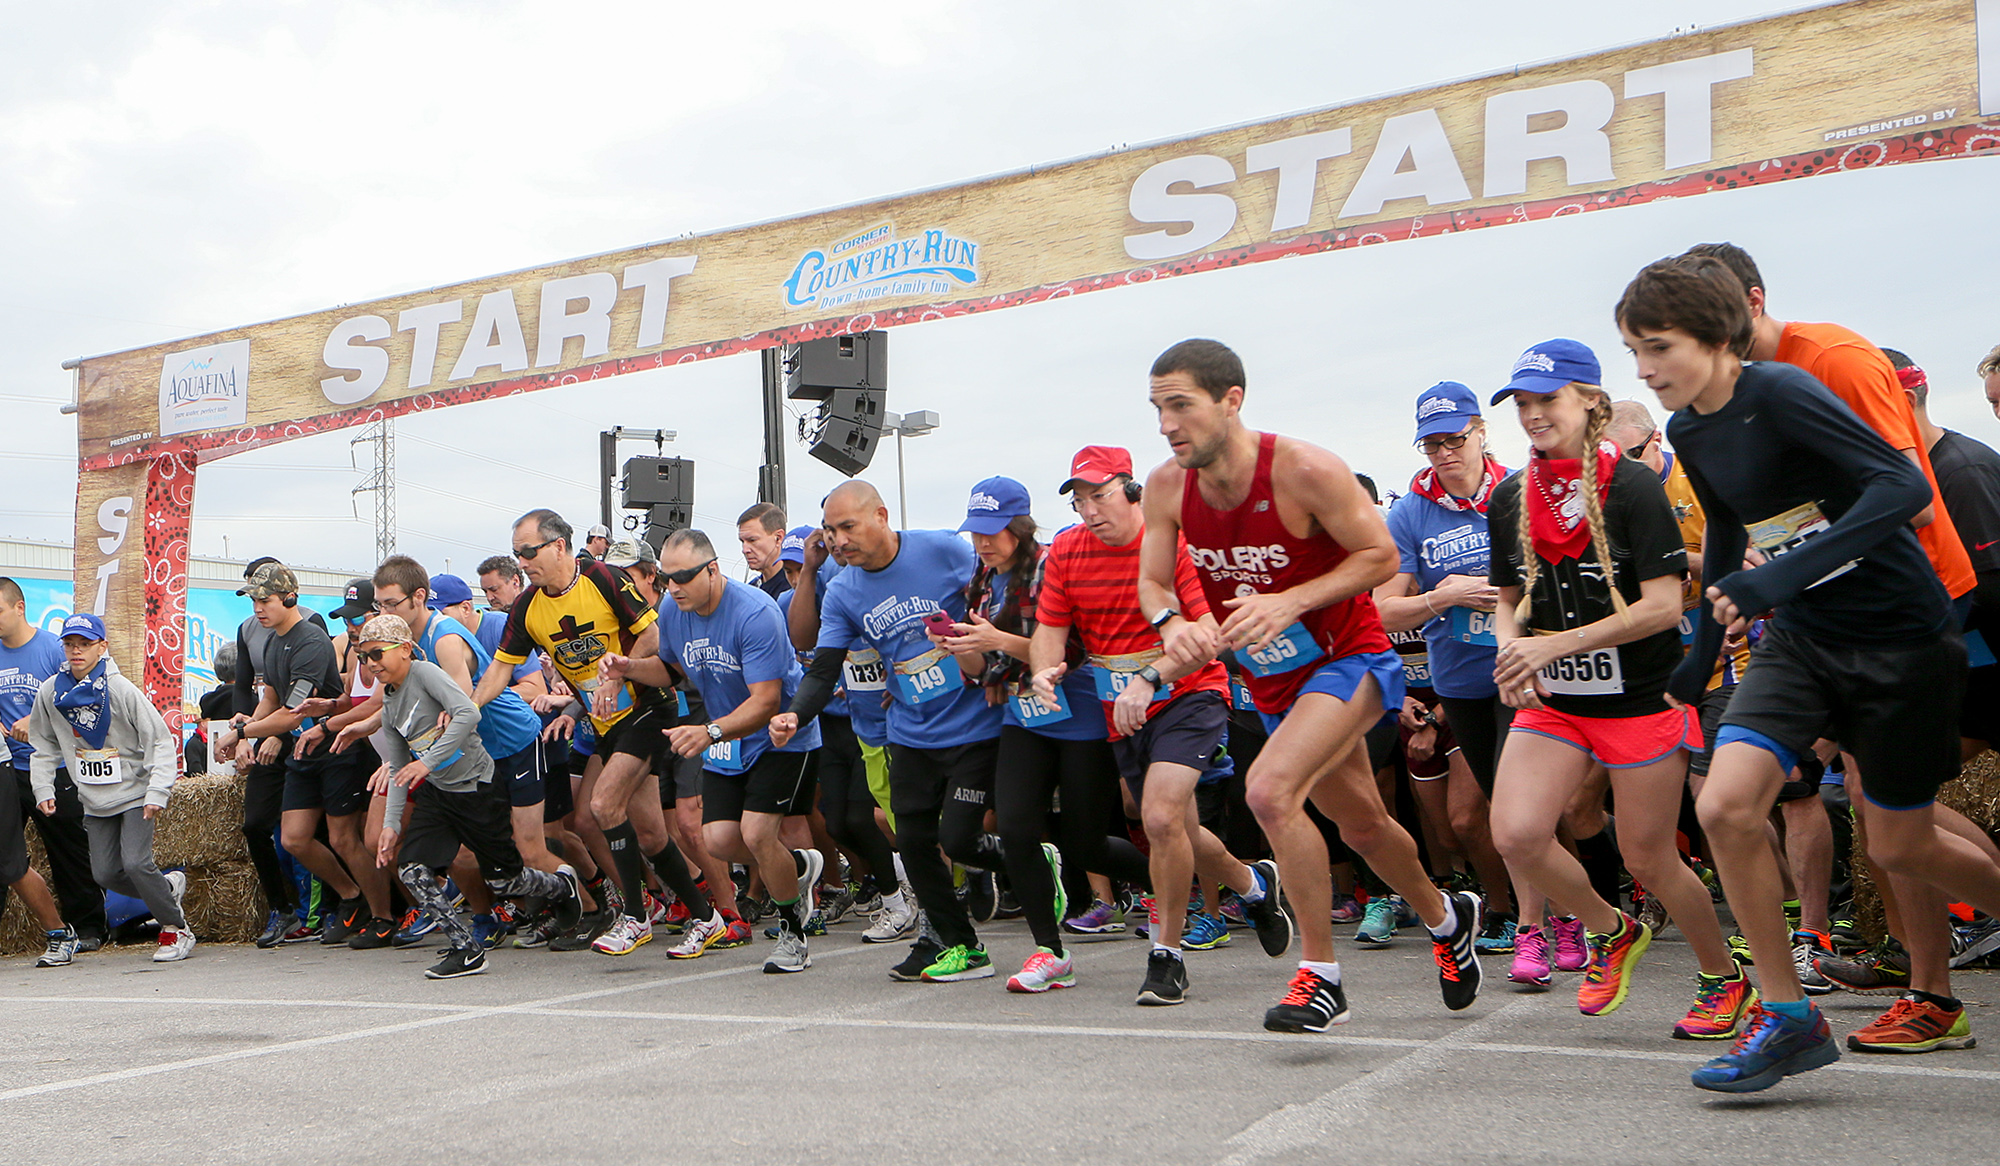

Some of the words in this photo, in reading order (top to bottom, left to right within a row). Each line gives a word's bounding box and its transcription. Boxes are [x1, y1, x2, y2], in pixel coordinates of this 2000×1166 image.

[1823, 112, 1927, 142] PRESENTED
[1932, 107, 1957, 126] BY
[1123, 46, 1754, 261] START
[833, 225, 889, 254] CORNER
[857, 234, 890, 250] STORE
[783, 238, 918, 306] COUNTRY
[920, 230, 977, 267] RUN
[819, 284, 888, 310] Down-home
[890, 280, 927, 295] family
[929, 279, 949, 293] fun
[320, 255, 698, 404] START
[166, 364, 239, 408] AQUAFINA
[109, 435, 141, 447] PRESENTED
[1187, 544, 1290, 571] SOLER'S
[1421, 532, 1488, 569] COUNTRY
[1210, 570, 1273, 584] SPORTS
[863, 601, 911, 640] COUNTRY
[910, 596, 941, 612] RUN
[1469, 611, 1497, 635] 64
[554, 634, 605, 657] FCA
[909, 665, 946, 694] 149
[1110, 672, 1137, 692] 67
[1402, 665, 1432, 681] 35
[1018, 694, 1051, 718] 615
[708, 741, 732, 761] 609
[80, 760, 113, 777] 3105
[954, 787, 986, 804] ARMY
